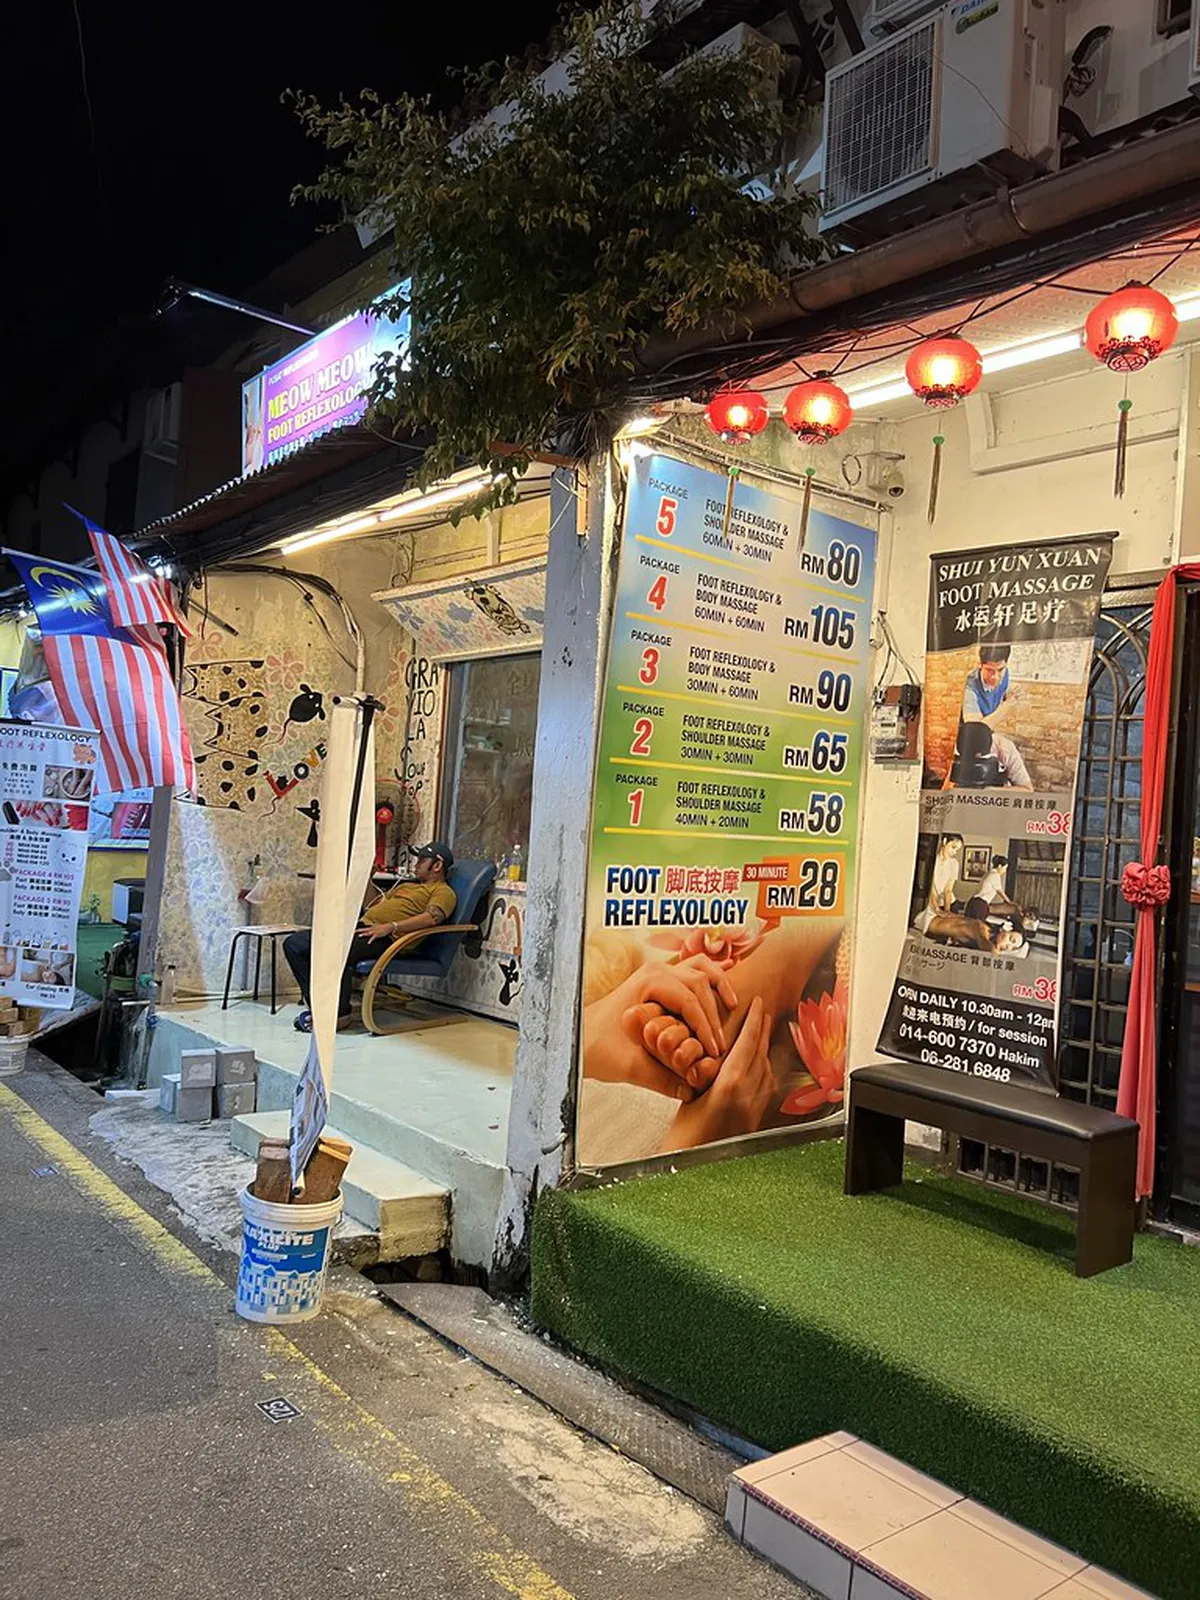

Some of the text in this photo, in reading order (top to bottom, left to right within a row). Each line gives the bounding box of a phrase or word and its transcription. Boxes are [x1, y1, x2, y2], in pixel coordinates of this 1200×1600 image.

[267, 374, 314, 422] MEOW
[267, 418, 294, 444] FOOT
[649, 478, 688, 499] PACKAGE
[657, 498, 677, 536] 5
[705, 499, 789, 535] FOOT REFLEXOLOGY &
[702, 532, 734, 551] 60MIN
[743, 543, 772, 562] 30MIN
[747, 528, 784, 550] MASSAGE
[640, 556, 680, 574] PACKAGE
[801, 541, 860, 586] RM 80
[939, 548, 1101, 582] SHUI YUN XUAN
[648, 575, 668, 611] 4
[695, 589, 758, 614] BODY MASSAGE
[697, 573, 782, 605] FOOT REFLEXOLOGY &
[938, 574, 1095, 608] FOOT MASSAGE
[694, 606, 726, 623] 60MIN
[735, 615, 765, 632] 60MIN
[784, 605, 856, 650] RM 105
[631, 630, 672, 646] PACKAGE
[640, 648, 659, 684] 3
[689, 646, 776, 673] FOOT REFLEXOLOGY &
[688, 662, 752, 684] BODY MASSAGE
[686, 678, 718, 694] 30MIN
[728, 685, 759, 700] 60MIN
[789, 670, 852, 711] RM 90
[623, 702, 664, 716] PACKAGE
[0, 727, 92, 743] OOT REFLEXOLOGY
[632, 719, 653, 754] 2
[683, 715, 770, 737] FOOT REFLEXOLOGY &
[681, 730, 766, 751] SHOULDER MASSAGE
[784, 731, 847, 772] RM 65
[680, 747, 713, 761] 30MIN
[723, 751, 754, 765] 30MIN
[262, 742, 328, 797] LOVE
[615, 774, 658, 786] PACKAGE
[678, 781, 766, 799] FOOT REFLEXOLOGY &
[957, 794, 1010, 807] MASSAGE
[629, 789, 644, 825] 1
[676, 796, 762, 813] SHOULDER MASSAGE
[780, 794, 843, 834] RM 58
[675, 813, 708, 825] 40MIN
[718, 816, 749, 828] 20MIN
[1027, 822, 1045, 832] RM
[606, 868, 740, 894] FOOT 脚底按摩
[746, 867, 788, 878] 30 MINUTE
[767, 861, 839, 907] RM 28
[605, 899, 749, 926] REFLEXOLOGY
[1013, 986, 1032, 997] RM
[920, 991, 957, 1008] DAILY
[961, 1000, 1014, 1021] 10.30am
[900, 1023, 1040, 1068] 014-600 7370 Hakim
[968, 1020, 975, 1031] /
[978, 1023, 996, 1036] for
[999, 1027, 1048, 1047] session
